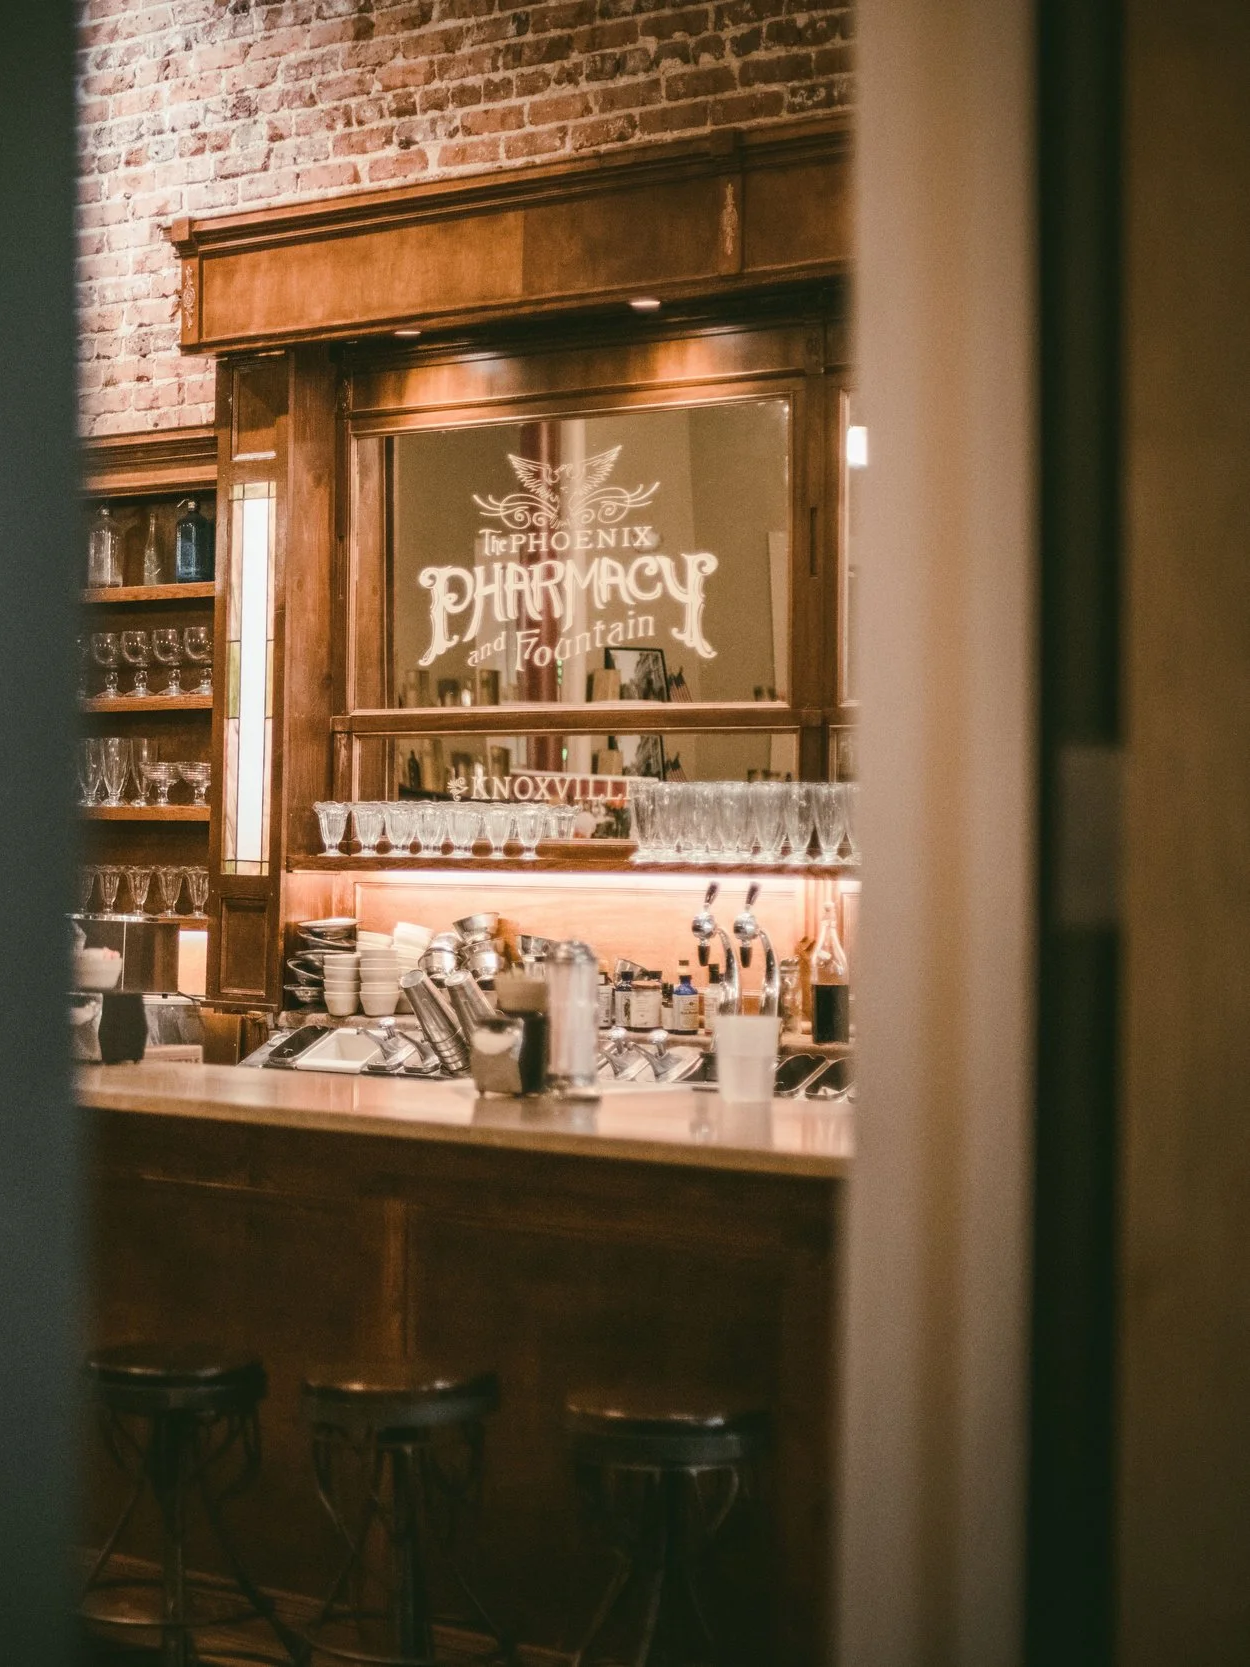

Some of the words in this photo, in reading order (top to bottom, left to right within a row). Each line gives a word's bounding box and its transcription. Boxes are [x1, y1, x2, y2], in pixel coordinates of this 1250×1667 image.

[478, 528, 507, 556] The
[509, 526, 652, 553] PHOENIX
[418, 553, 719, 667] PHARMACY
[467, 631, 507, 667] and
[515, 610, 656, 672] Fountain
